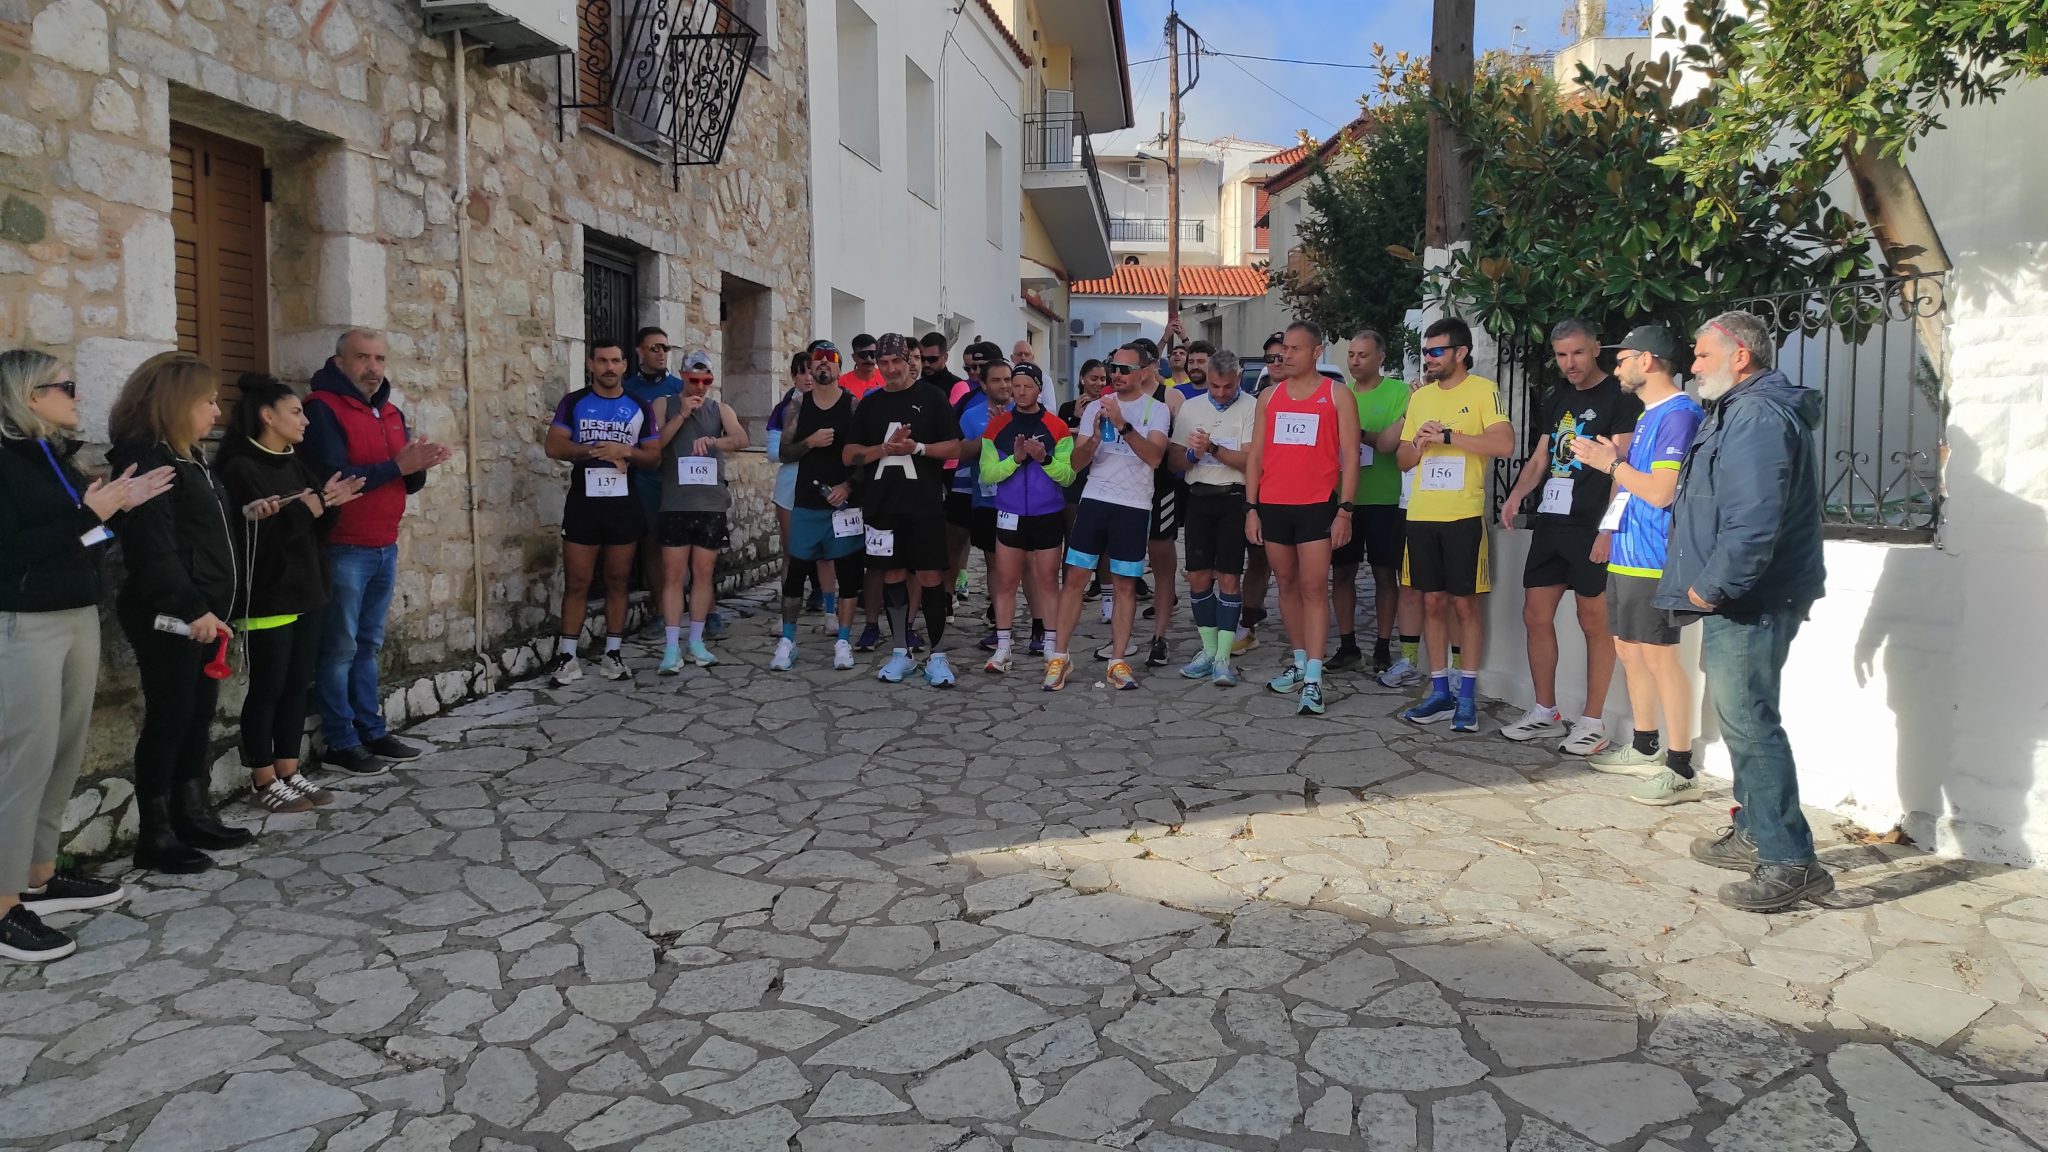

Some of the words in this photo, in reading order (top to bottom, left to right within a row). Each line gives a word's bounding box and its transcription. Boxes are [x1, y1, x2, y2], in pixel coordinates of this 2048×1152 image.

[579, 419, 633, 435] DESFINA
[1286, 423, 1306, 434] 162
[579, 430, 633, 445] RUNNERS
[690, 465, 708, 475] 168
[1430, 467, 1452, 479] 156
[597, 477, 617, 487] 137
[844, 516, 860, 527] 140
